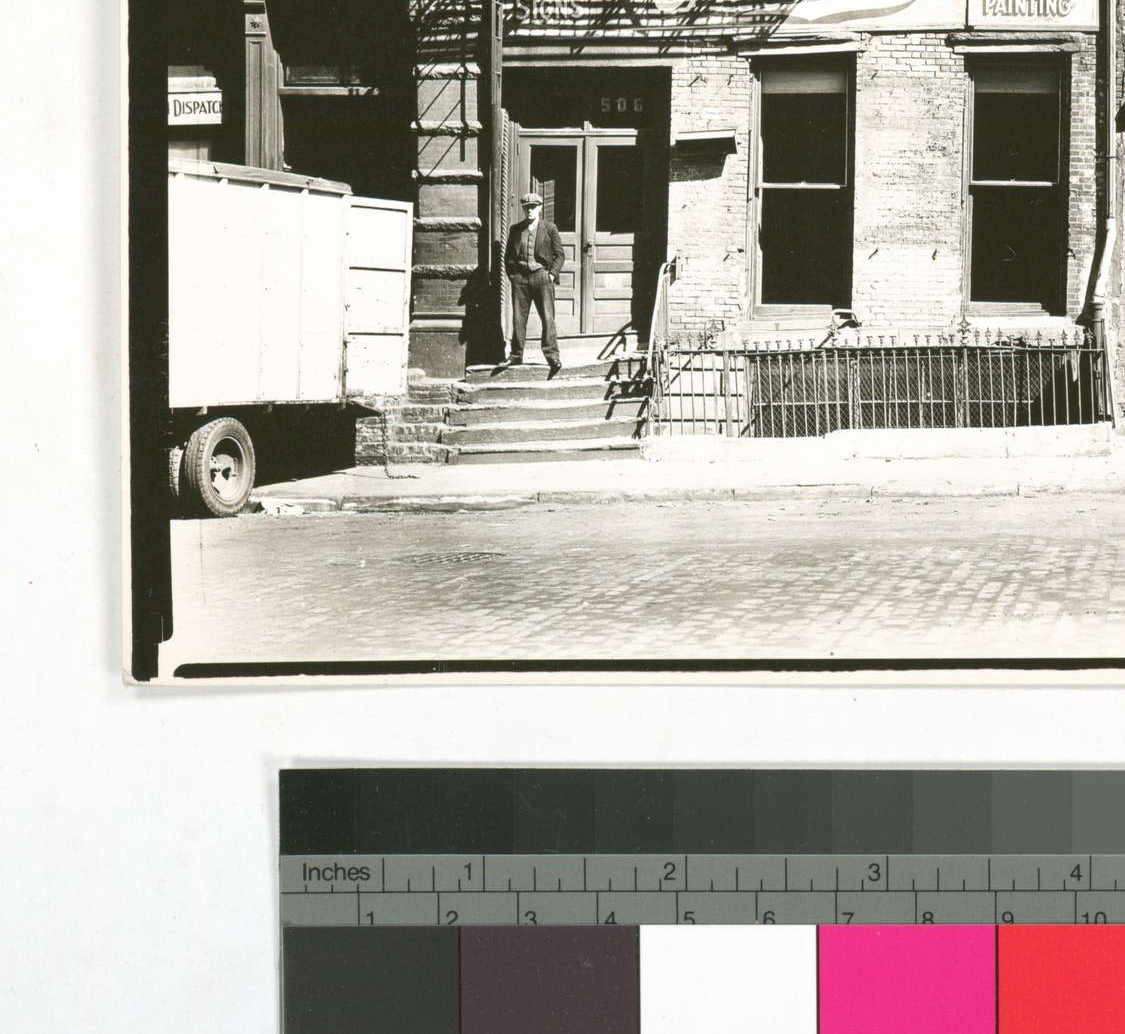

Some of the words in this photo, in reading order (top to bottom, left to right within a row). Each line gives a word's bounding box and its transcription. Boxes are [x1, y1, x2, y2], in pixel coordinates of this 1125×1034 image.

[601, 97, 644, 112] 506
[302, 863, 370, 881] Inches
[463, 863, 473, 882] 1
[663, 863, 676, 882] 2
[867, 863, 881, 882] 3
[1069, 863, 1083, 882] 4
[366, 911, 375, 924] 1
[445, 911, 459, 924] 2
[524, 911, 537, 924] 3
[603, 911, 617, 924] 4
[684, 911, 696, 924] 5
[762, 911, 776, 924] 6
[841, 911, 855, 924] 7
[921, 911, 935, 924] 8
[1001, 911, 1015, 924] 9
[1081, 911, 1107, 924] 10
